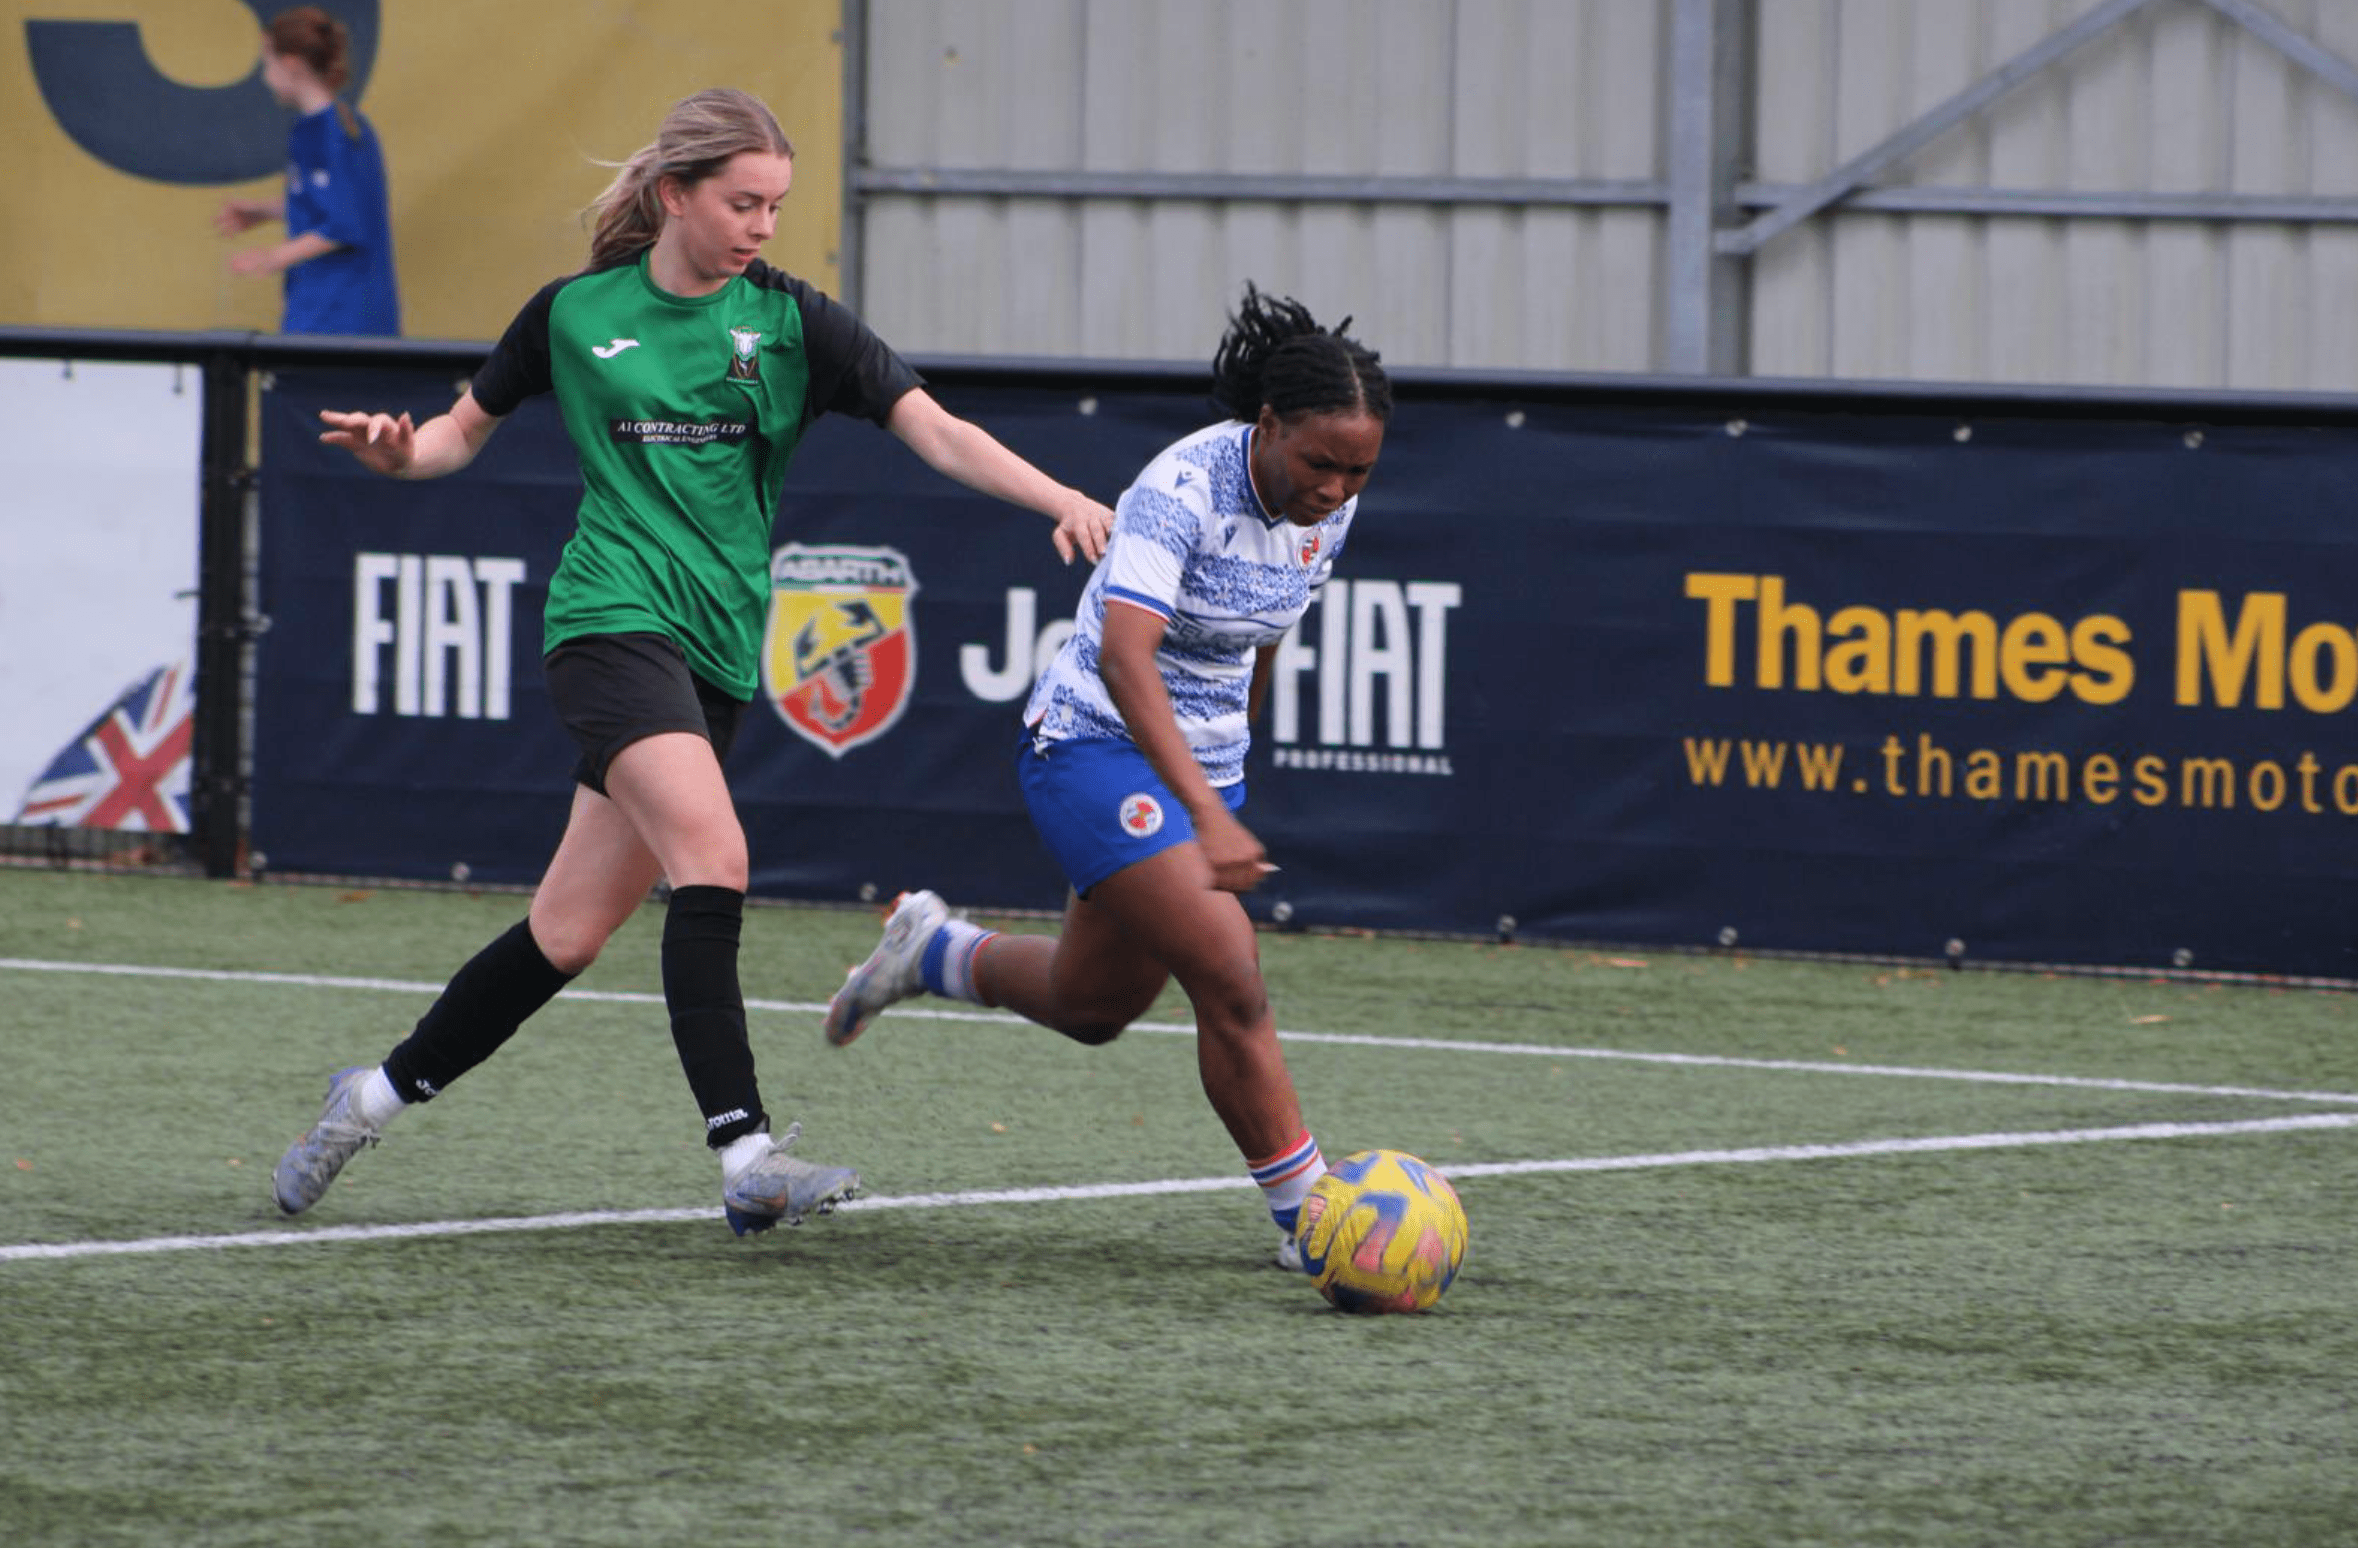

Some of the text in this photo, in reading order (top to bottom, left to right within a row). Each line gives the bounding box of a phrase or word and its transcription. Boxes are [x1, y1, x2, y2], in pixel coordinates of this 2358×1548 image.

[634, 421, 719, 437] CONTRACTING
[720, 423, 746, 434] LTD
[352, 552, 526, 720] FIAT
[1272, 577, 1463, 750] FIAT
[1684, 572, 2135, 705] Thames
[1272, 747, 1454, 776] PROFESSIONAL
[1683, 733, 2358, 816] www.thamesmoto
